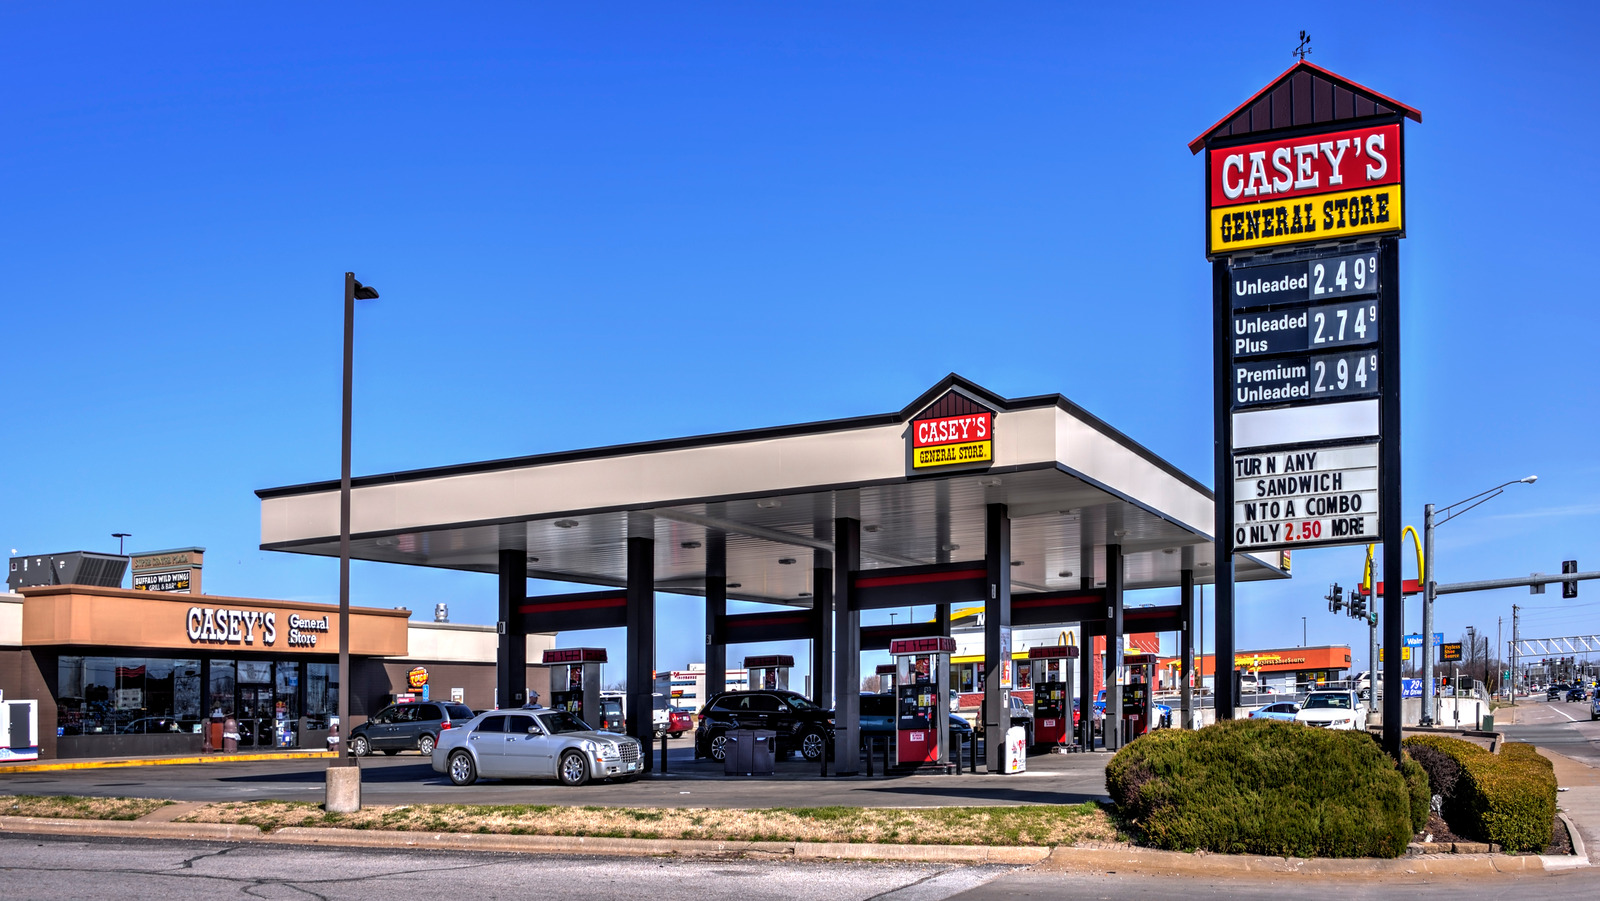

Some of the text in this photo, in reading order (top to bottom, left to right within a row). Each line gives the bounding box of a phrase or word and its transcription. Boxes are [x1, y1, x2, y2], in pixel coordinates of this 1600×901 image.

[1222, 133, 1388, 200] CASEY'S
[1221, 192, 1389, 243] GENERAL STORE
[1235, 273, 1308, 296] Unleaded
[1235, 312, 1307, 335] Unleaded
[1235, 338, 1268, 354] Plus
[1237, 364, 1306, 384] Premium
[1237, 381, 1309, 403] Unleaded
[919, 416, 986, 444] CASEY'S
[919, 444, 984, 464] GENERAL STORE
[1284, 452, 1317, 473] ANY
[1257, 472, 1342, 497] SANDWICH
[1285, 500, 1295, 518] A
[1305, 493, 1362, 516] COMBO
[1236, 517, 1364, 545] ONLY 2.50 MORE
[135, 572, 189, 586] BUFFALO WILD WINGS
[187, 606, 276, 644] CASEY'S
[289, 613, 330, 630] General
[288, 629, 317, 645] Store
